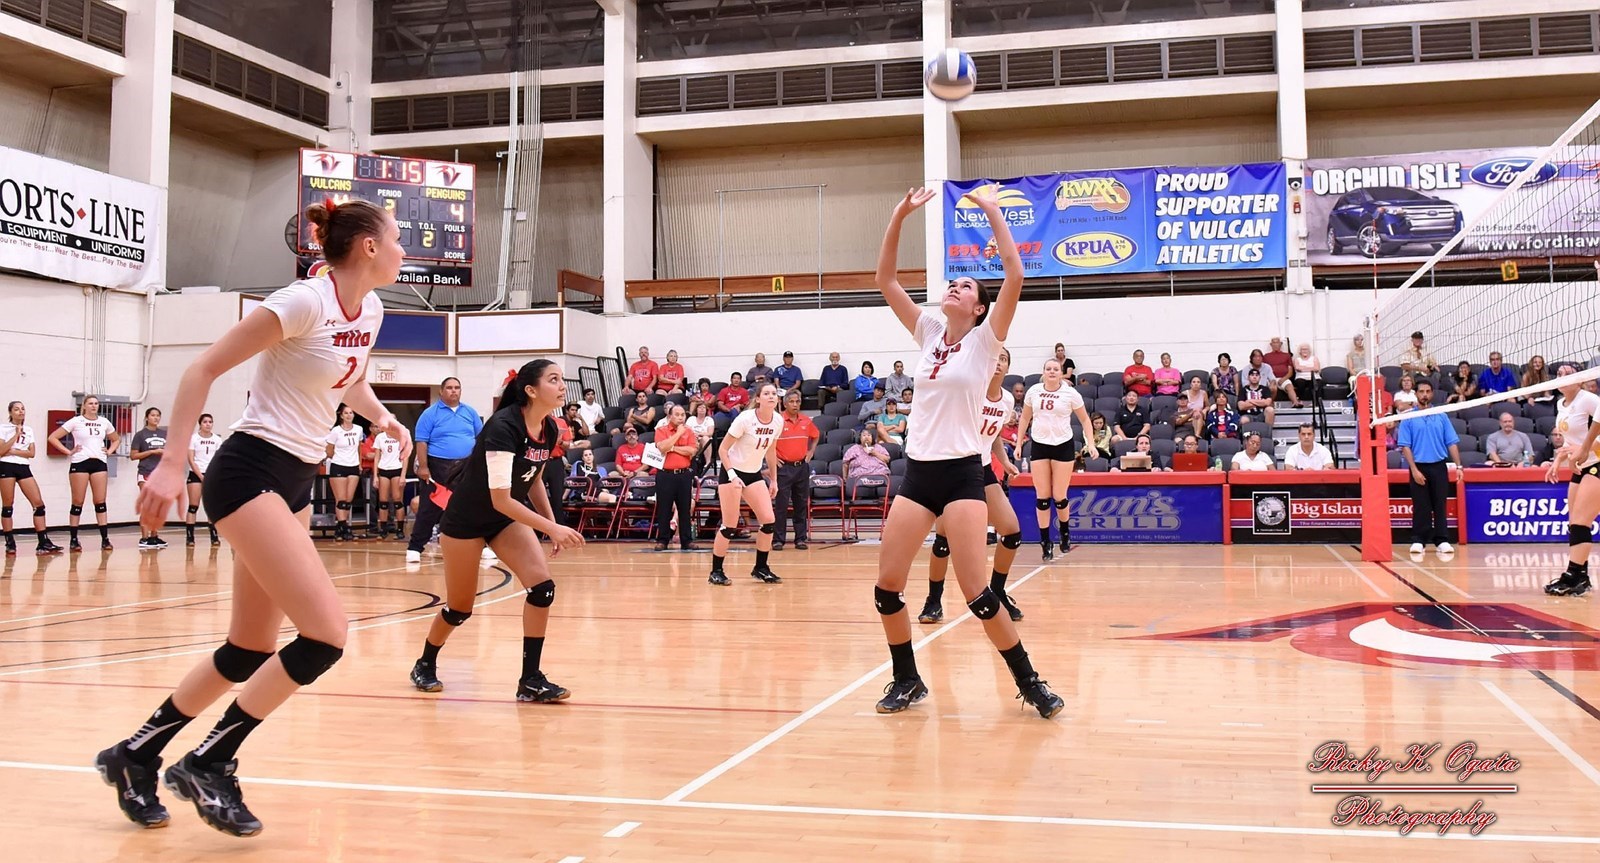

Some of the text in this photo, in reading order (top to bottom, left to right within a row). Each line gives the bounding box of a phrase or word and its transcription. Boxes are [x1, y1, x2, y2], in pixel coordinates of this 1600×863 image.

[382, 160, 422, 183] 1:15
[1312, 162, 1462, 195] ORCHID ISLE
[1485, 161, 1541, 184] Fod
[310, 179, 352, 191] VULCANS
[1155, 172, 1229, 192] PROUD
[377, 189, 402, 197] PERIOD
[425, 187, 466, 200] PENGUINS
[1062, 179, 1127, 204] KWXX
[0, 178, 146, 244] ORTS LINE
[1155, 194, 1280, 216] SUPPORTER
[451, 203, 464, 222] 4
[444, 224, 466, 232] FOULS
[954, 220, 1012, 229] BROADCAG
[1157, 218, 1271, 240] OF VULCAN
[7, 222, 68, 245] EQUIPMENT
[91, 240, 143, 260] UNIFORMS
[20, 239, 32, 248] The
[422, 230, 434, 248] 2
[444, 251, 466, 259] SCORE
[1064, 240, 1121, 259] KPUA
[1156, 243, 1264, 265] ATHLETICS
[948, 264, 987, 273] Hawaii's
[1024, 262, 1043, 270] Hits
[396, 272, 462, 285] waiian Bank
[775, 278, 783, 291] A
[331, 356, 358, 389] 2
[380, 371, 395, 381] EXIT
[1040, 399, 1055, 411] 18
[89, 427, 100, 436] 15
[980, 419, 999, 436] 16
[347, 437, 356, 446] 11
[755, 437, 770, 450] 14
[387, 445, 393, 453] 8
[521, 465, 537, 482] 4
[1291, 502, 1363, 518] Big Islan
[1068, 516, 1173, 529] GRILL
